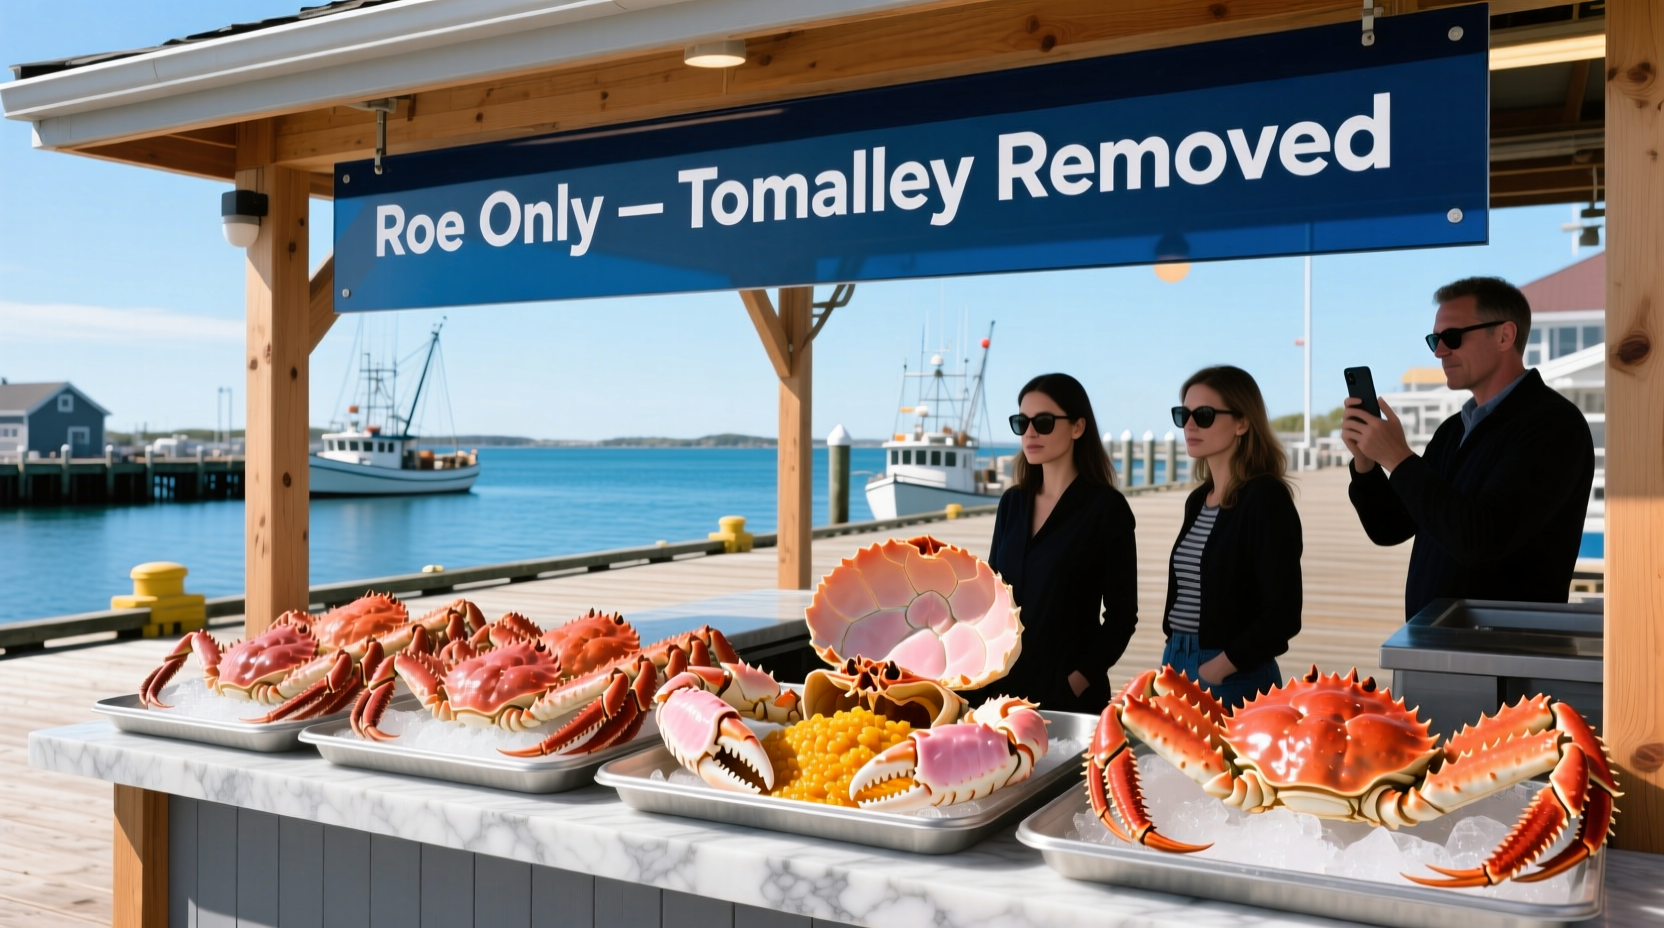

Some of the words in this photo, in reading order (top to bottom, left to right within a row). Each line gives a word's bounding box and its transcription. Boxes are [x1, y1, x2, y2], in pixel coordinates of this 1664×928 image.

[376, 204, 465, 257] Roe
[479, 183, 604, 257] Only
[618, 202, 664, 217] —
[678, 146, 975, 228] Tomalley
[998, 92, 1391, 201] Removed
